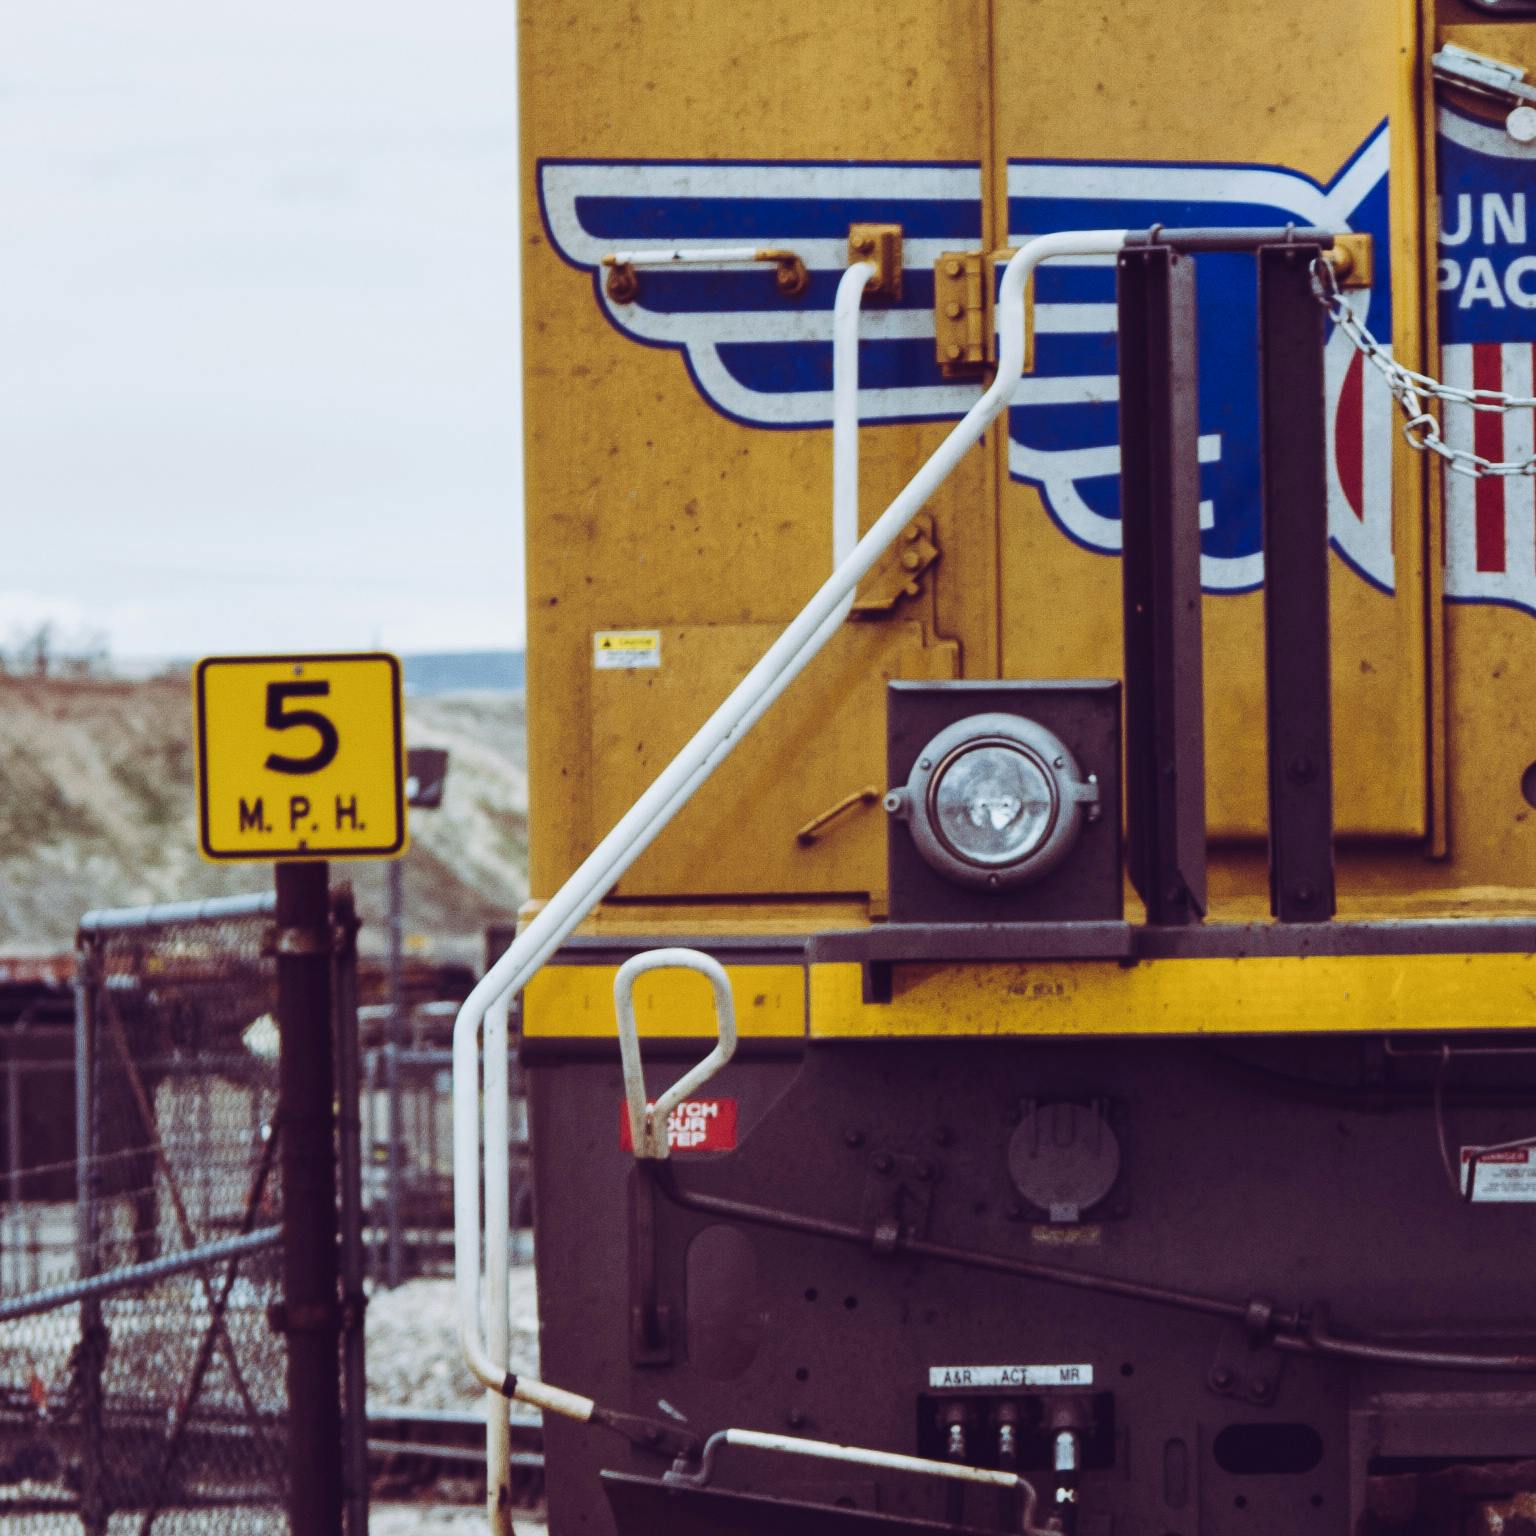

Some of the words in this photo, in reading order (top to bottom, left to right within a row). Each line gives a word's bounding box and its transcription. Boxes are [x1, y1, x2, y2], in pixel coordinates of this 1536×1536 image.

[265, 680, 339, 775] 5
[943, 1370, 972, 1384] A&R
[1001, 1369, 1028, 1384] ACT
[1059, 1368, 1080, 1381] MR
